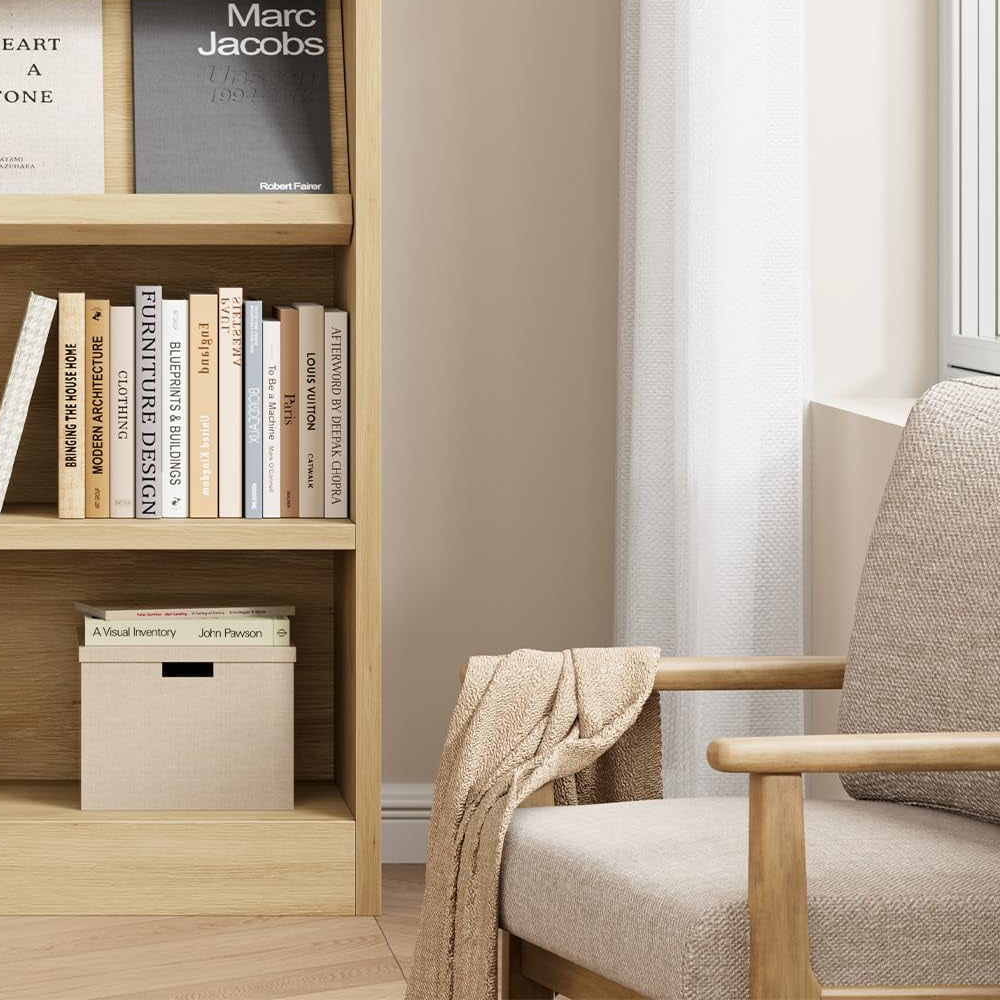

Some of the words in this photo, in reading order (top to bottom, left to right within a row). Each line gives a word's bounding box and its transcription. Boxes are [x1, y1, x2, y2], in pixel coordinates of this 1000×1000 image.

[228, 3, 317, 28] Marc
[198, 31, 325, 56] Jacobs
[27, 64, 41, 76] A
[260, 181, 293, 190] Robert
[294, 181, 322, 190] Fairer
[65, 344, 76, 368] HOME
[142, 291, 155, 423] FURNITURE
[268, 364, 277, 376] To
[307, 353, 315, 383] LOUIS
[332, 328, 341, 395] AFTERWORD
[65, 372, 77, 401] HOUSE
[92, 336, 105, 423] ARCHITECTURE
[170, 342, 181, 411] BLUEPRINTS
[268, 379, 276, 391] Be
[65, 404, 76, 421] THE
[118, 371, 127, 439] CLOTHING
[268, 402, 276, 440] Machine
[284, 394, 296, 426] Paris
[307, 387, 316, 430] VUITTON
[332, 399, 341, 413] BY
[65, 424, 78, 467] BRINGING
[92, 426, 105, 474] MODERN
[332, 416, 341, 457] DEEPAK
[170, 426, 181, 485] BUILDINGS
[306, 454, 314, 489] CATWALK
[142, 432, 155, 514] DESIGN
[332, 461, 341, 504] CHOPRA
[93, 627, 101, 636] A
[103, 627, 130, 637] Visual
[134, 627, 176, 639] Inventory
[199, 628, 221, 638] John
[225, 628, 262, 638] Pawson
